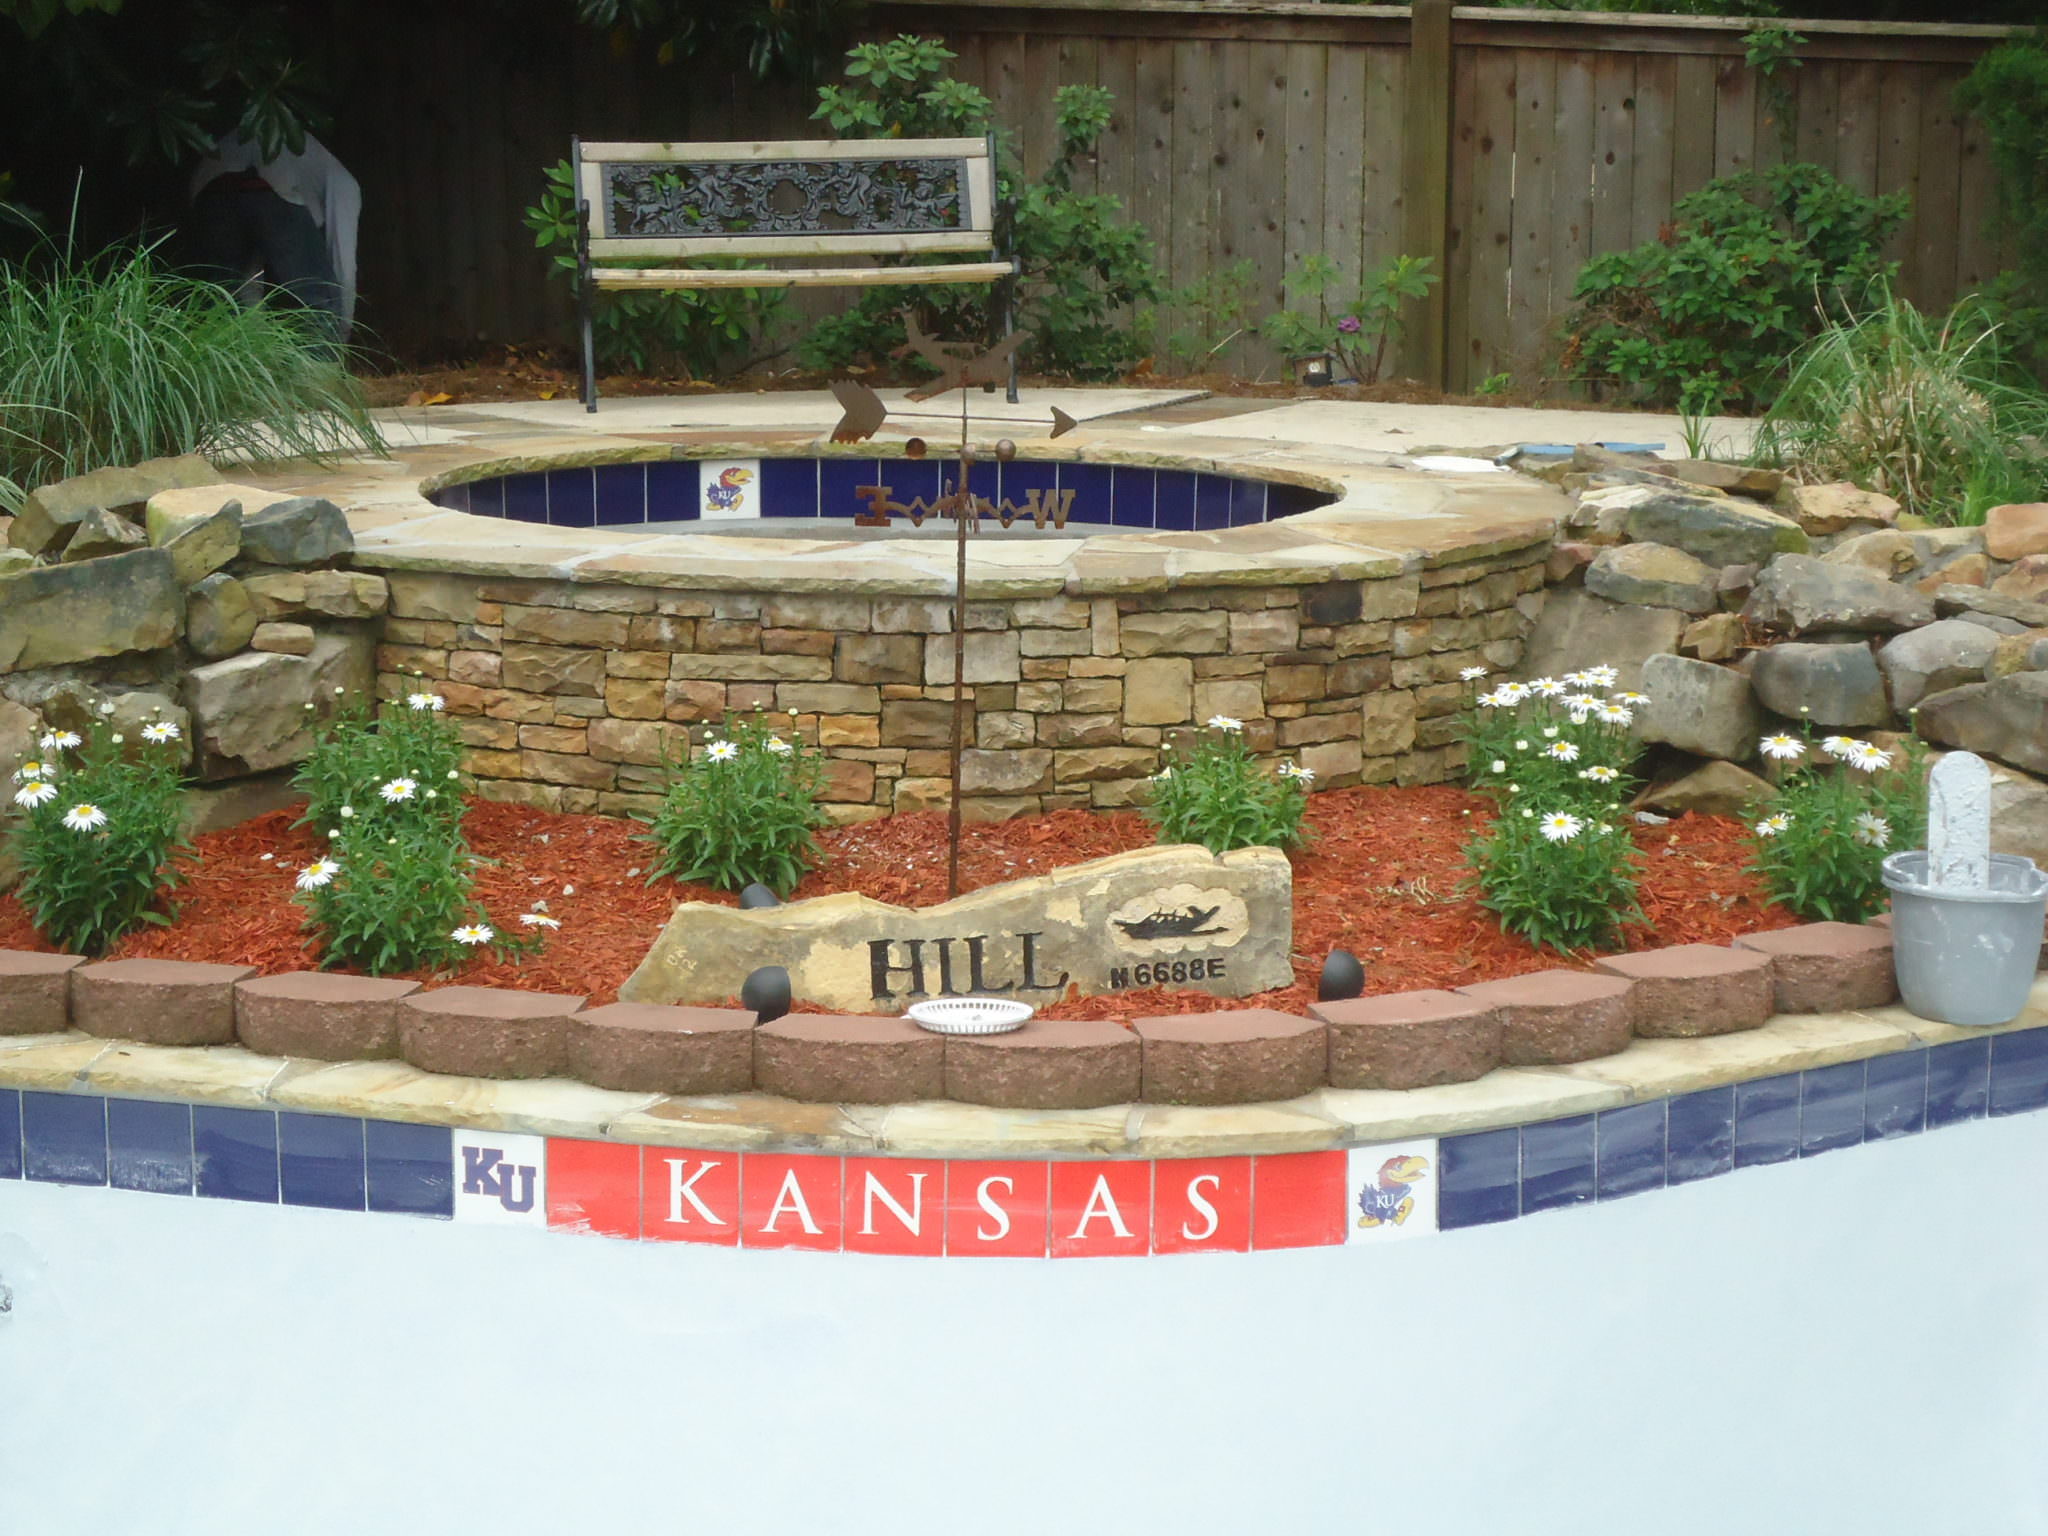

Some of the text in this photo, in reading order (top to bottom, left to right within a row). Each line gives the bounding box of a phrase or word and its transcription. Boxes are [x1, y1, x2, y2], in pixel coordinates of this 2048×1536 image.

[868, 931, 1069, 1000] HILL
[462, 1146, 536, 1212] KU
[663, 1158, 1220, 1240] KANSAS
[1376, 1194, 1395, 1208] KU
